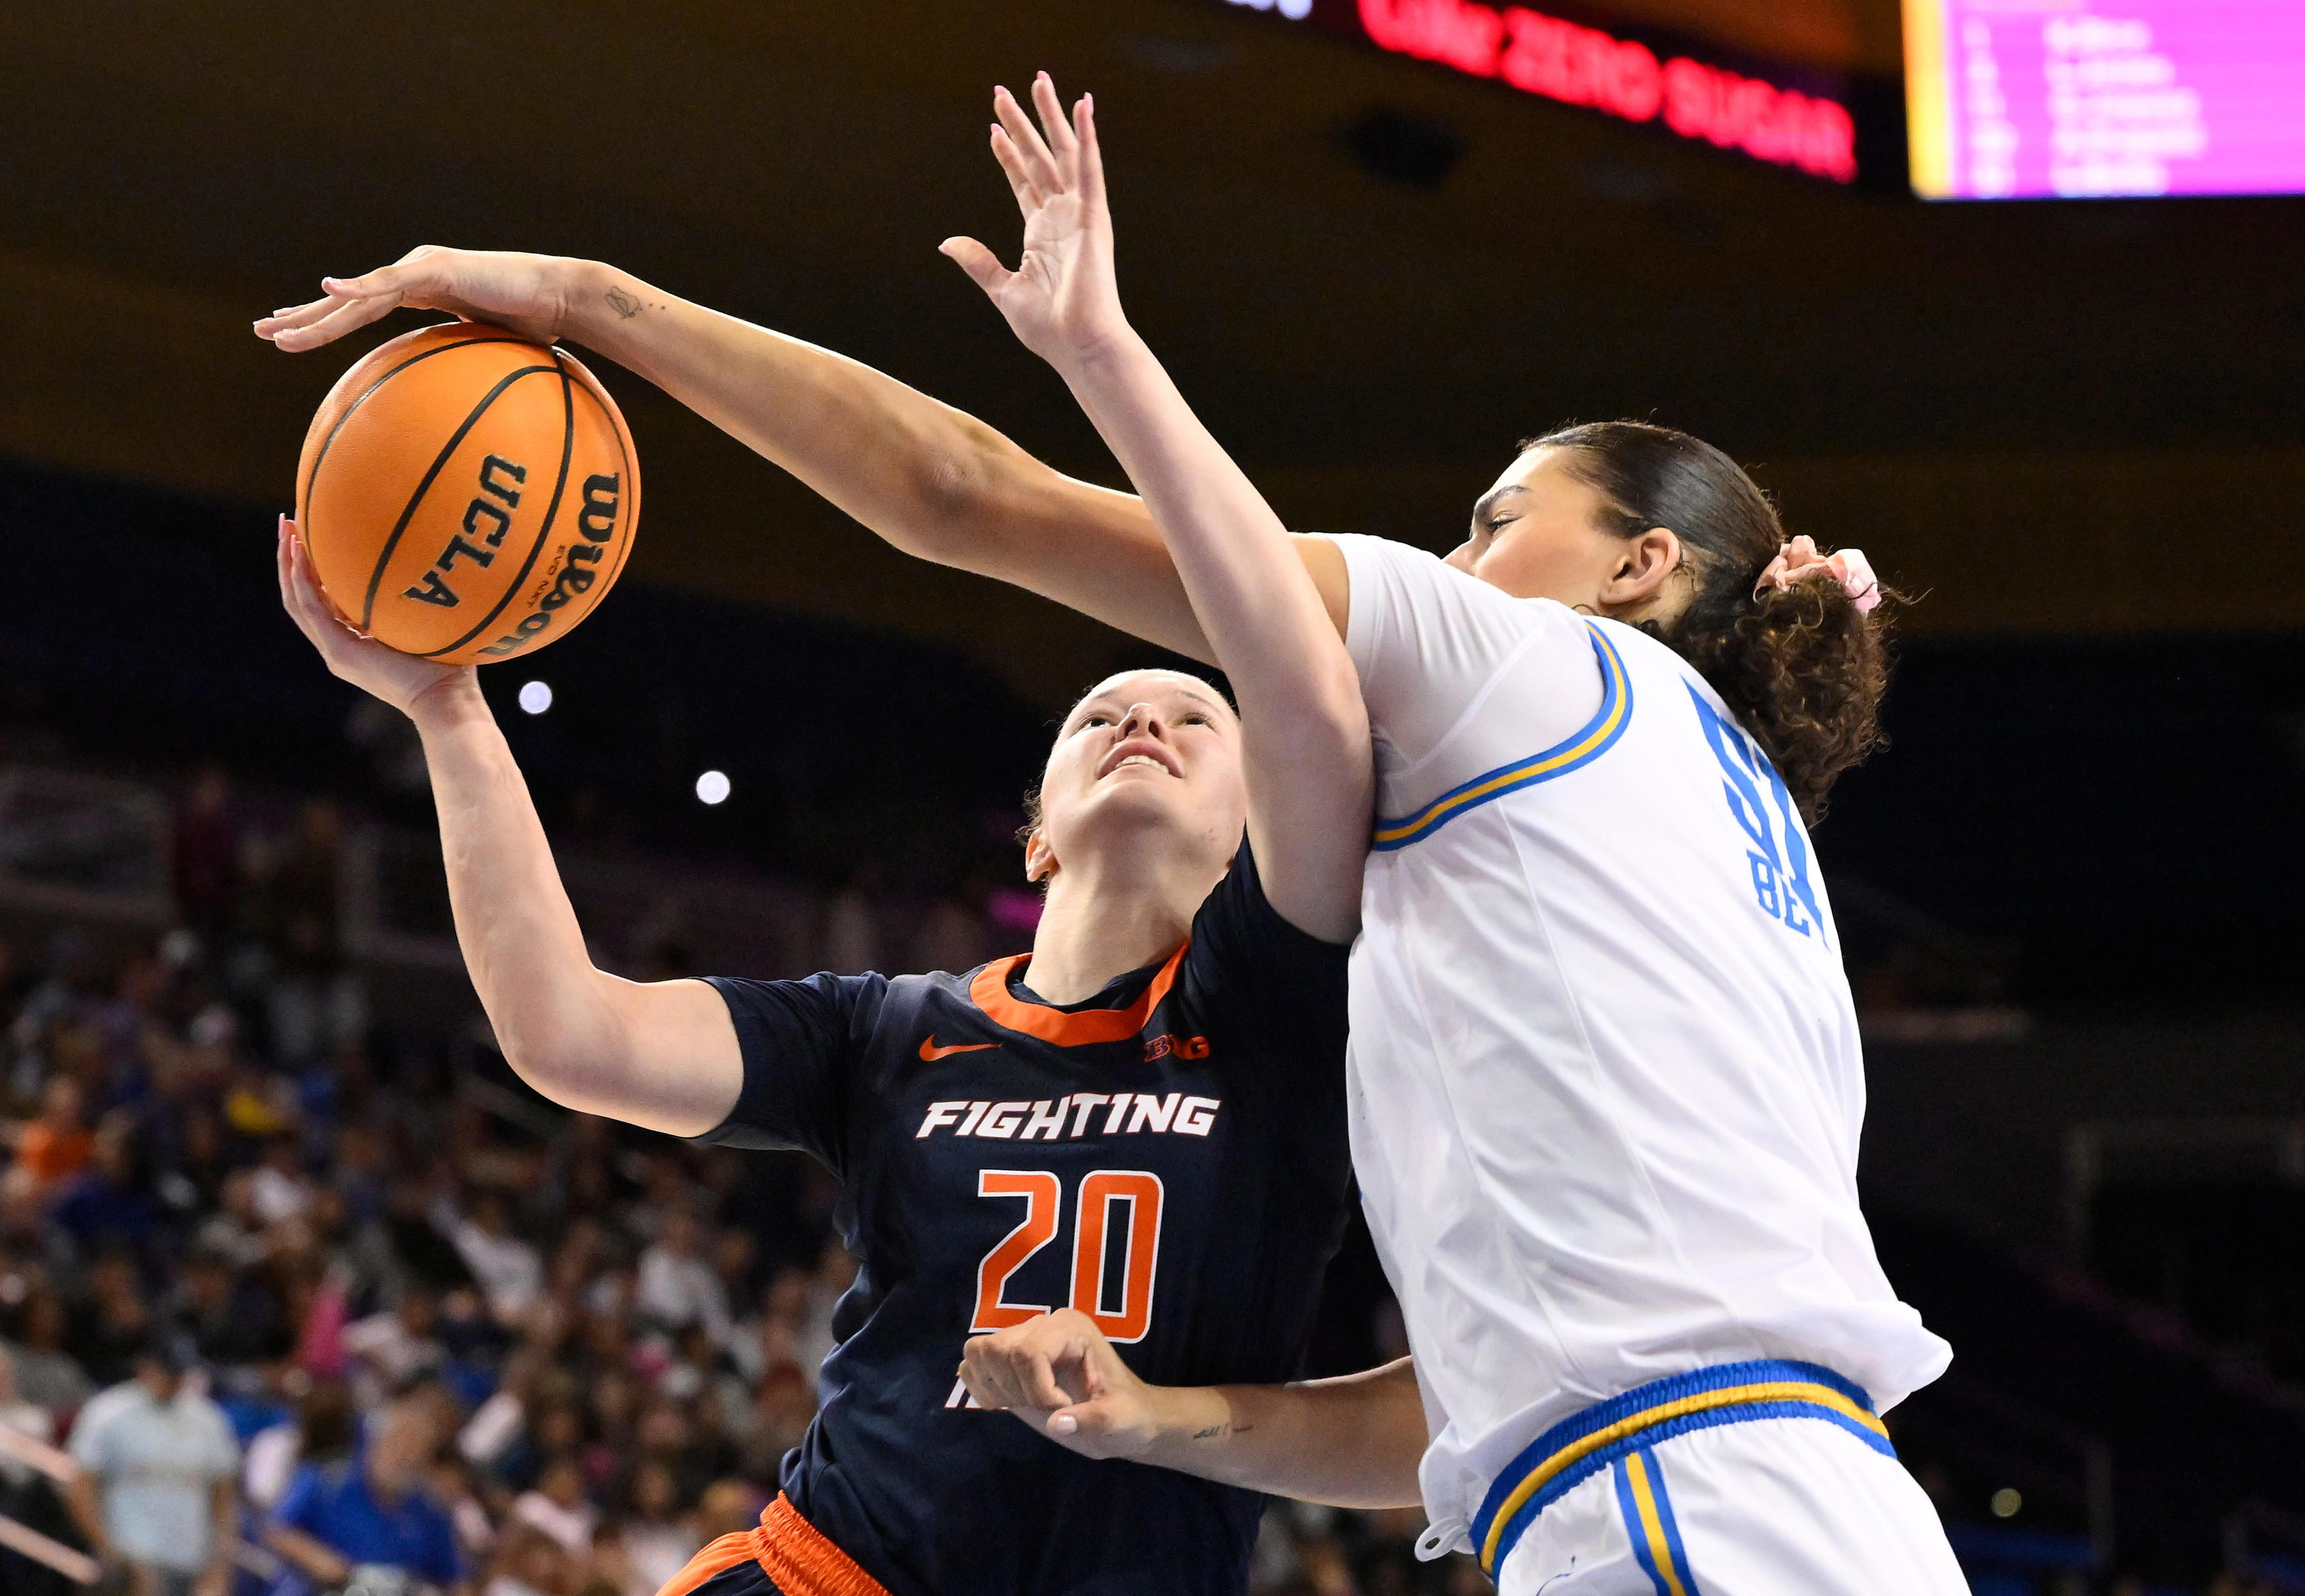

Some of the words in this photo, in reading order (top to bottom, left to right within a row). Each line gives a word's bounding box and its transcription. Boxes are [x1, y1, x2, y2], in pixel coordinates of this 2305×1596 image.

[403, 453, 527, 608] UCLA
[476, 472, 620, 656] Wilson
[916, 1092, 1221, 1140] FIGHTING
[968, 1169, 1164, 1344] 20
